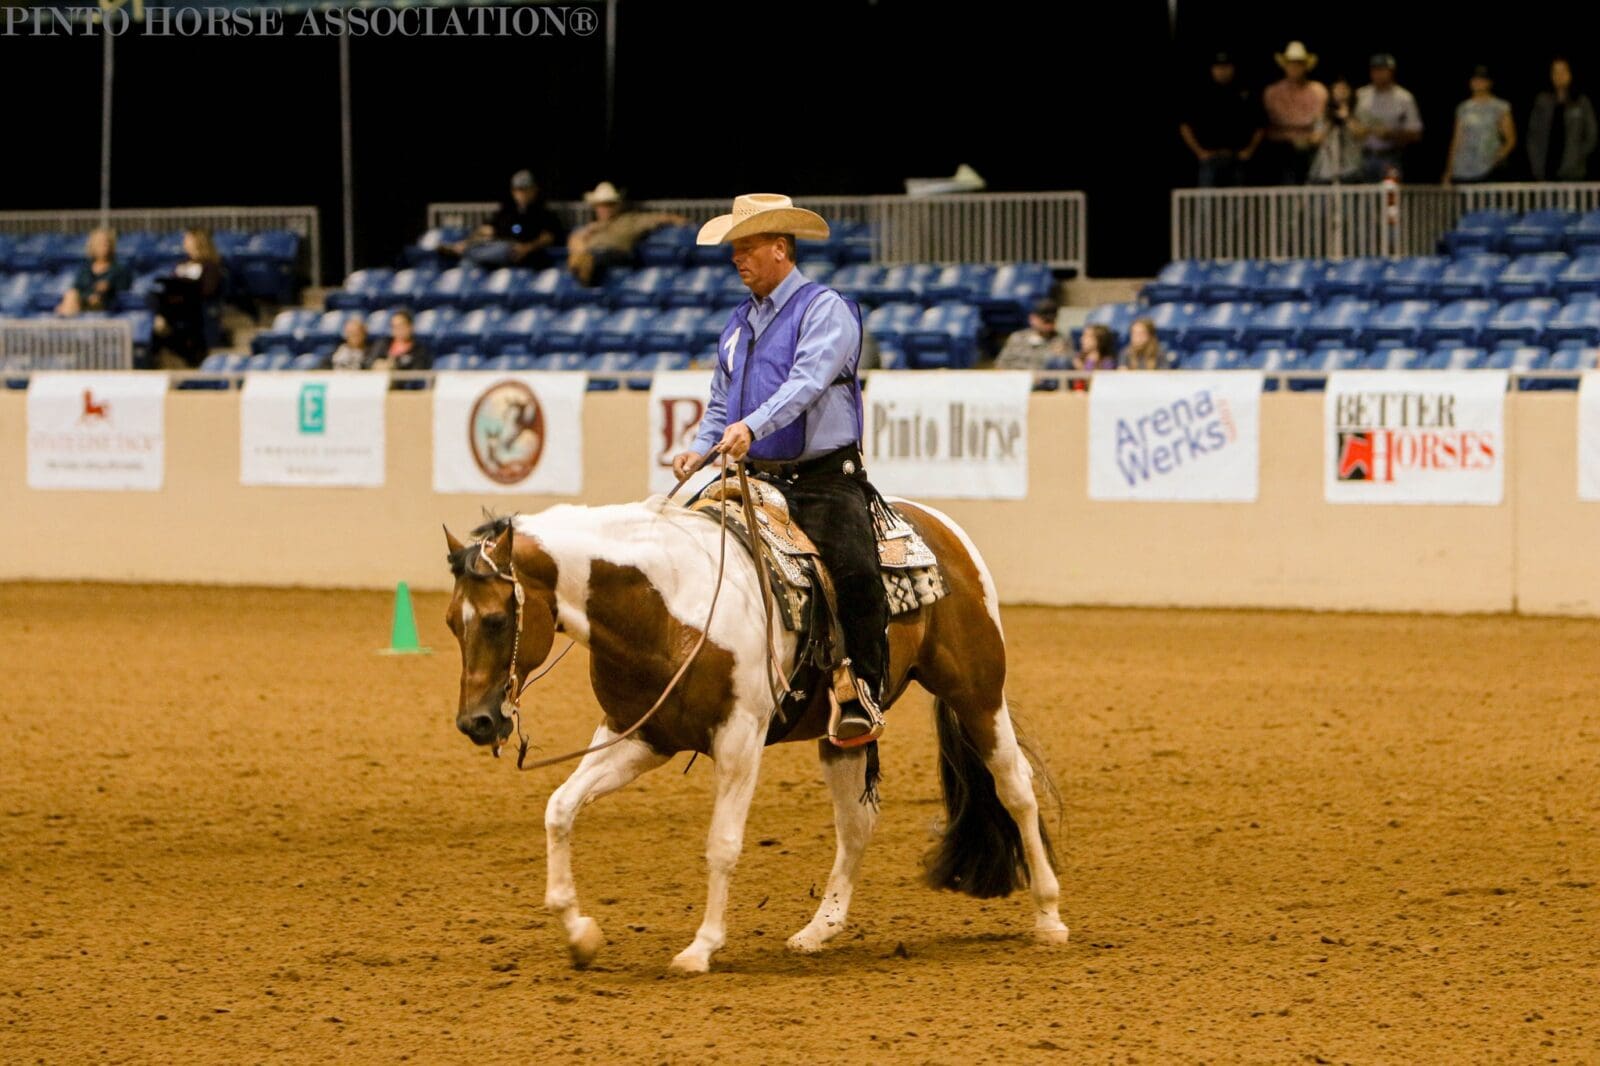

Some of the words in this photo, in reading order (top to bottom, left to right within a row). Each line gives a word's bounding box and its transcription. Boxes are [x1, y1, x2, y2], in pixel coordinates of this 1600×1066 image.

[723, 326, 742, 373] 1
[872, 400, 938, 458] Pinto
[949, 400, 1021, 458] Horse
[1116, 389, 1214, 451] Arena
[1336, 392, 1456, 427] BETTER
[1116, 419, 1227, 487] Werks
[1365, 431, 1495, 482] HORSES
